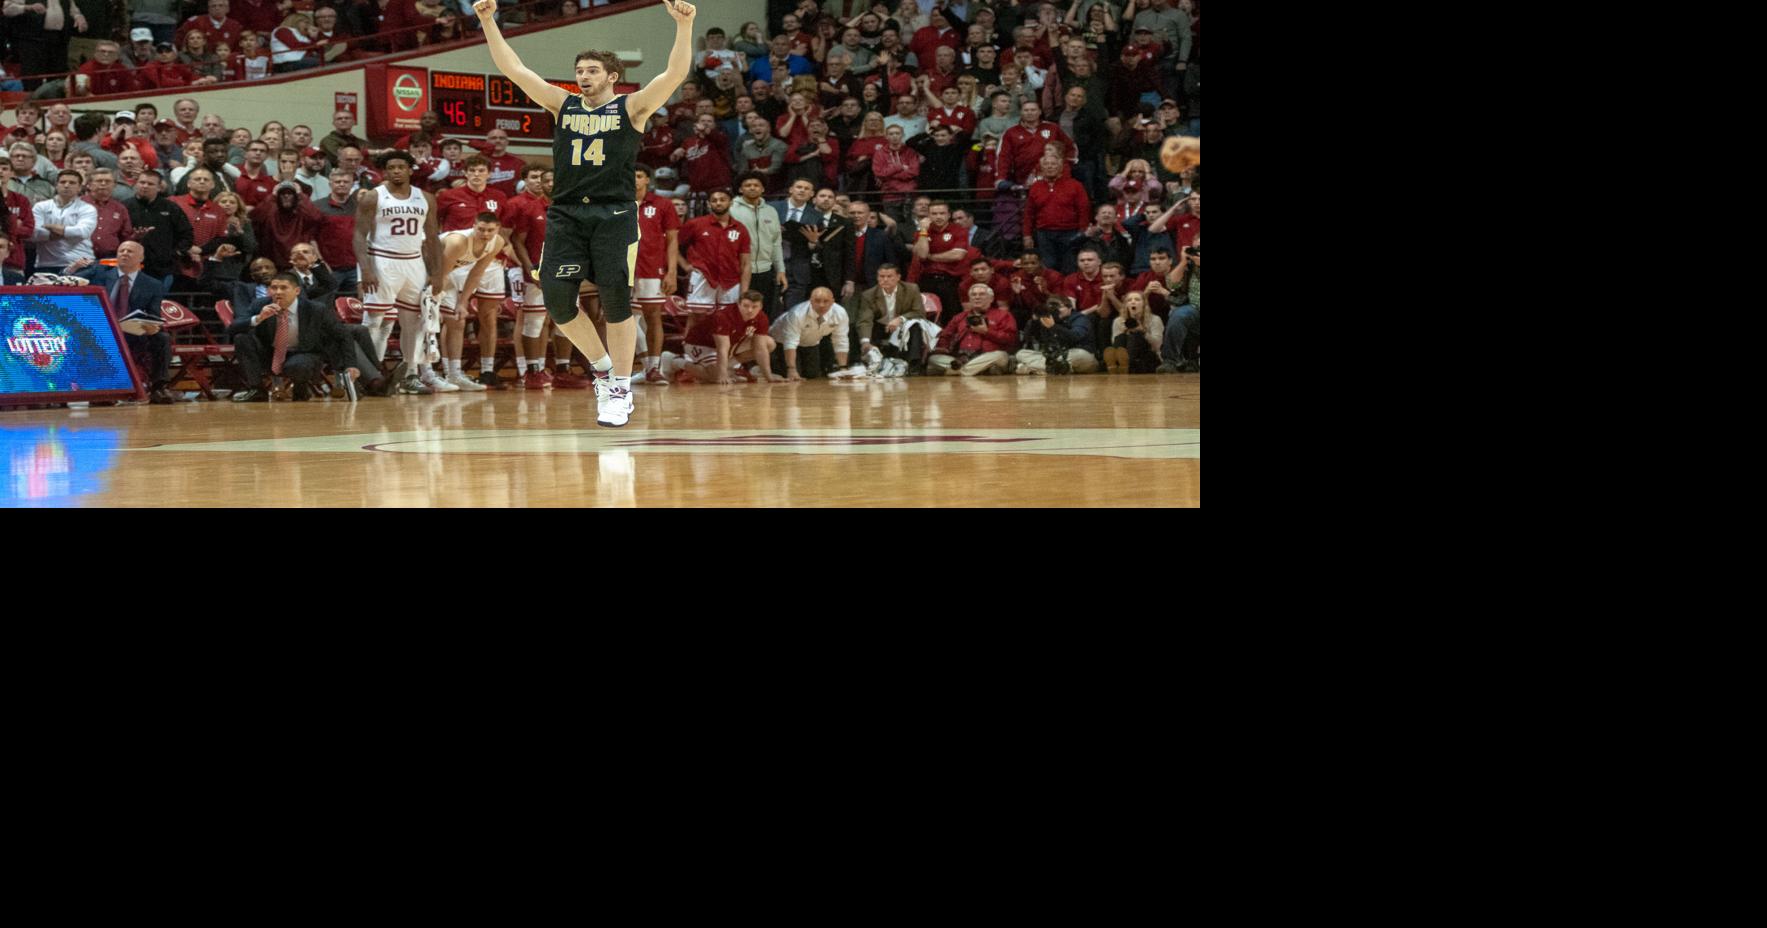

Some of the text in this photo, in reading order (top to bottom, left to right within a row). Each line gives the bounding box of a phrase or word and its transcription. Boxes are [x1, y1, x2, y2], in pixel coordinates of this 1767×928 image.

[433, 73, 485, 91] INDIANA
[443, 101, 467, 126] 46
[495, 118, 520, 131] PERIOD
[522, 114, 532, 133] 2
[561, 114, 621, 136] PURDUE
[571, 138, 606, 166] 14
[382, 205, 425, 217] INDIANA
[390, 217, 418, 236] 20
[7, 336, 67, 353] LOTTERY
